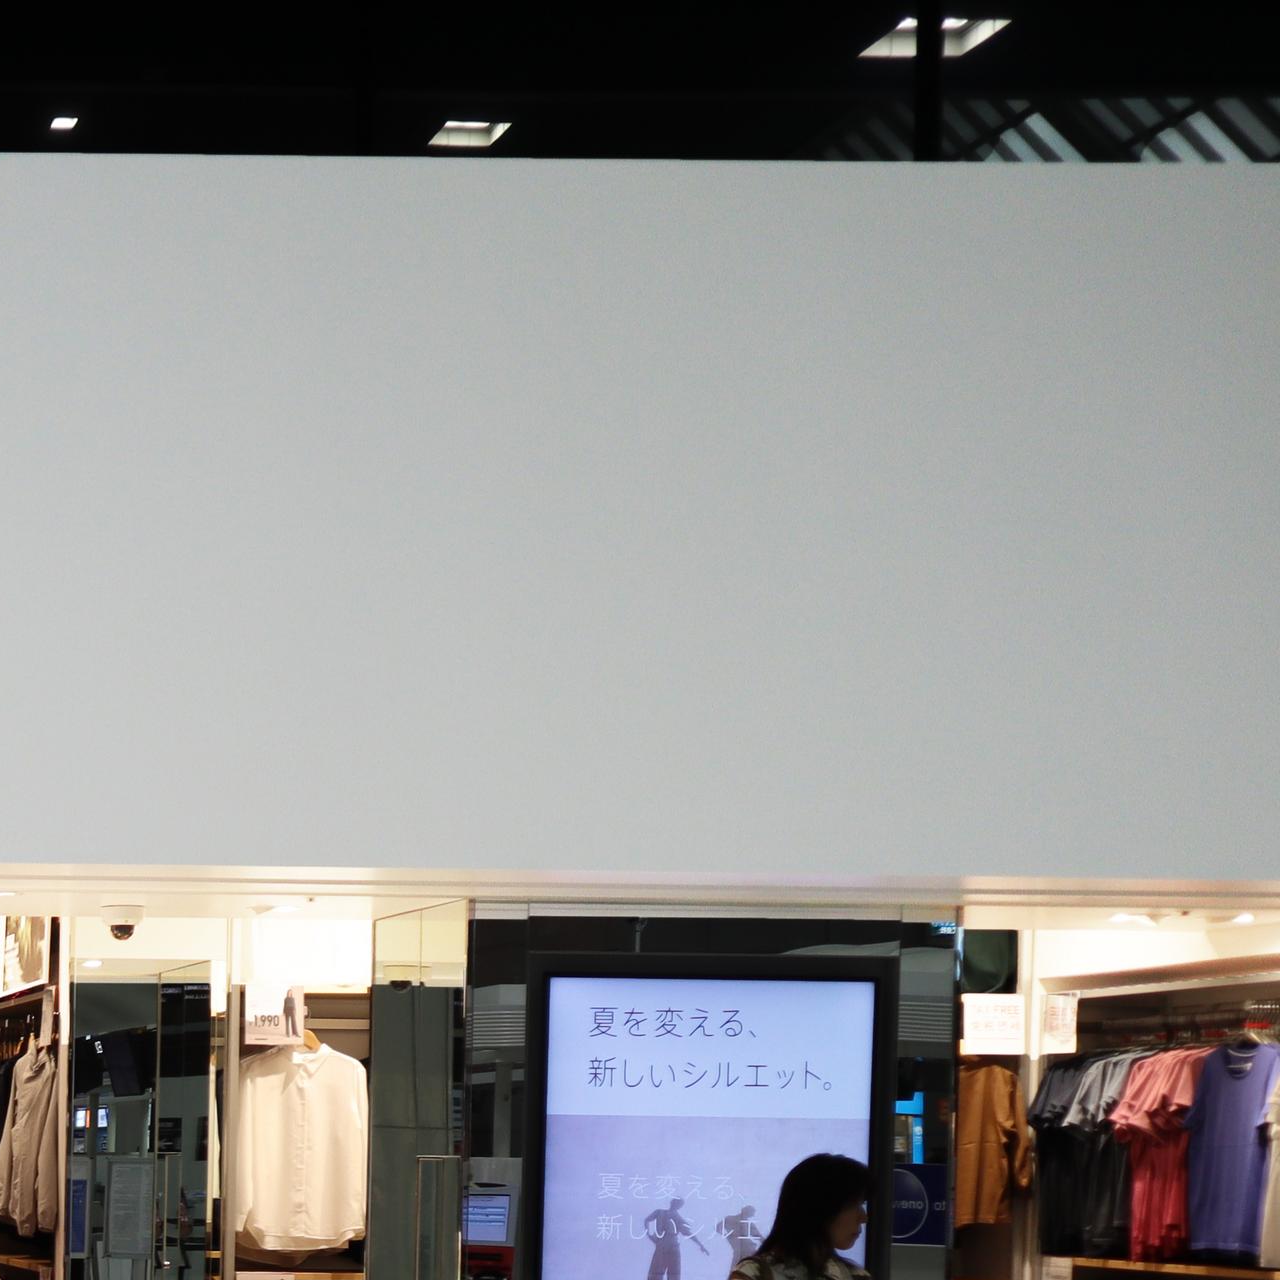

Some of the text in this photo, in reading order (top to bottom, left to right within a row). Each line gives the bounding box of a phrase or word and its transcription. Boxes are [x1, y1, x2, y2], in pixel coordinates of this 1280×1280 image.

[589, 1007, 756, 1038] 夏を変える、
[588, 1056, 832, 1091] 新しいシルエット。
[596, 1172, 744, 1200] 夏を変える、
[595, 1213, 761, 1240] 新しいシルエ
